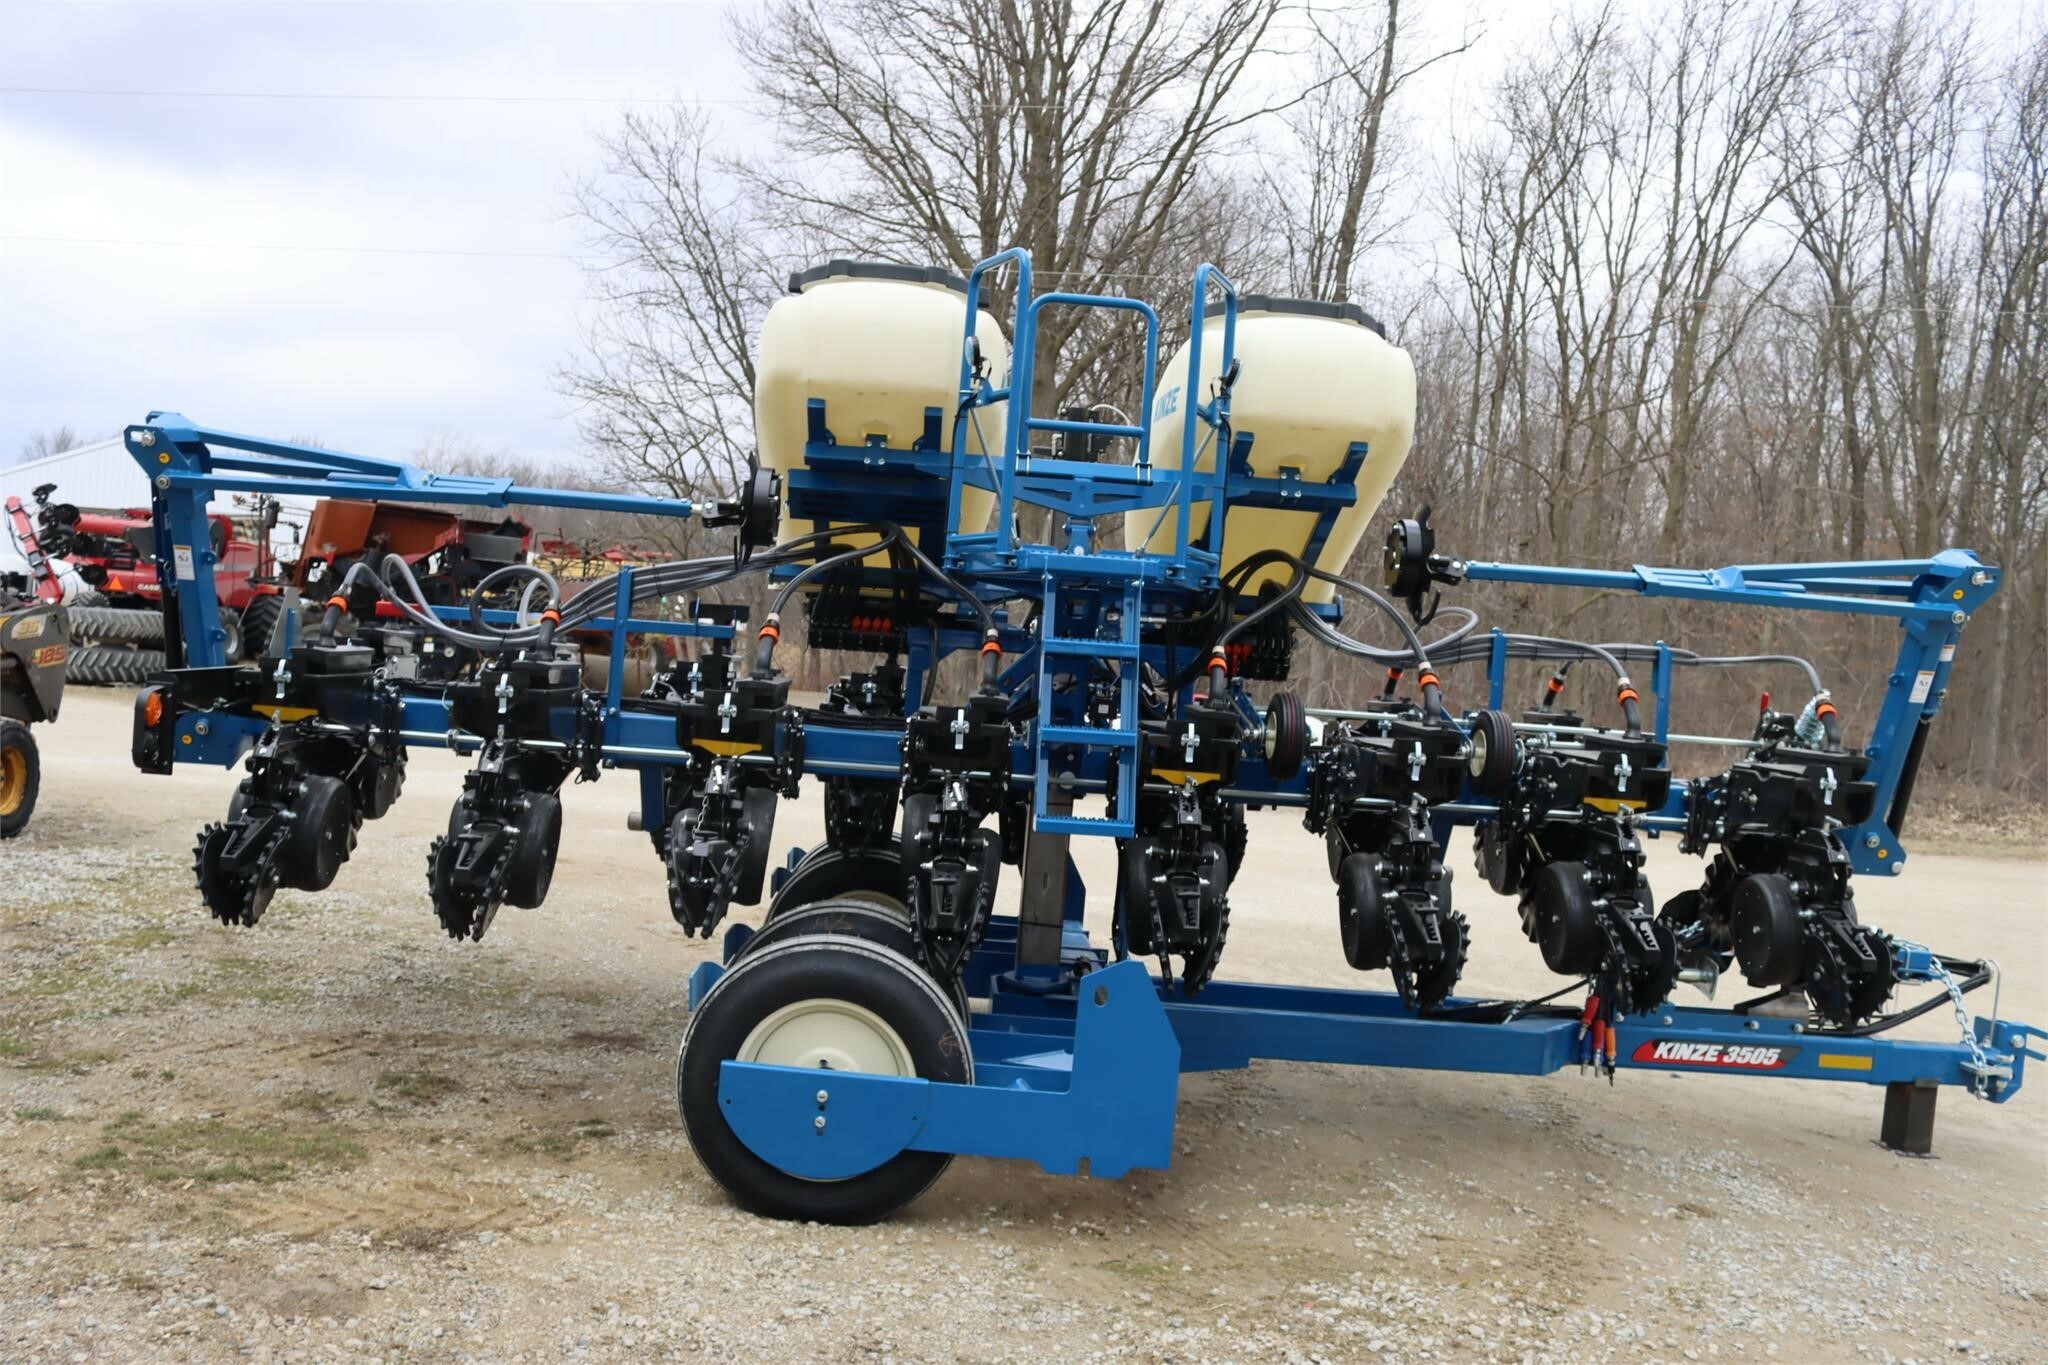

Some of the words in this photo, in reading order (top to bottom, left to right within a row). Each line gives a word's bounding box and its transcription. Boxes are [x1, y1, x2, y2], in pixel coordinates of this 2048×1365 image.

[1152, 385, 1181, 423] INZE
[1653, 1041, 1723, 1062] KINZE
[1722, 1045, 1781, 1066] 3505
